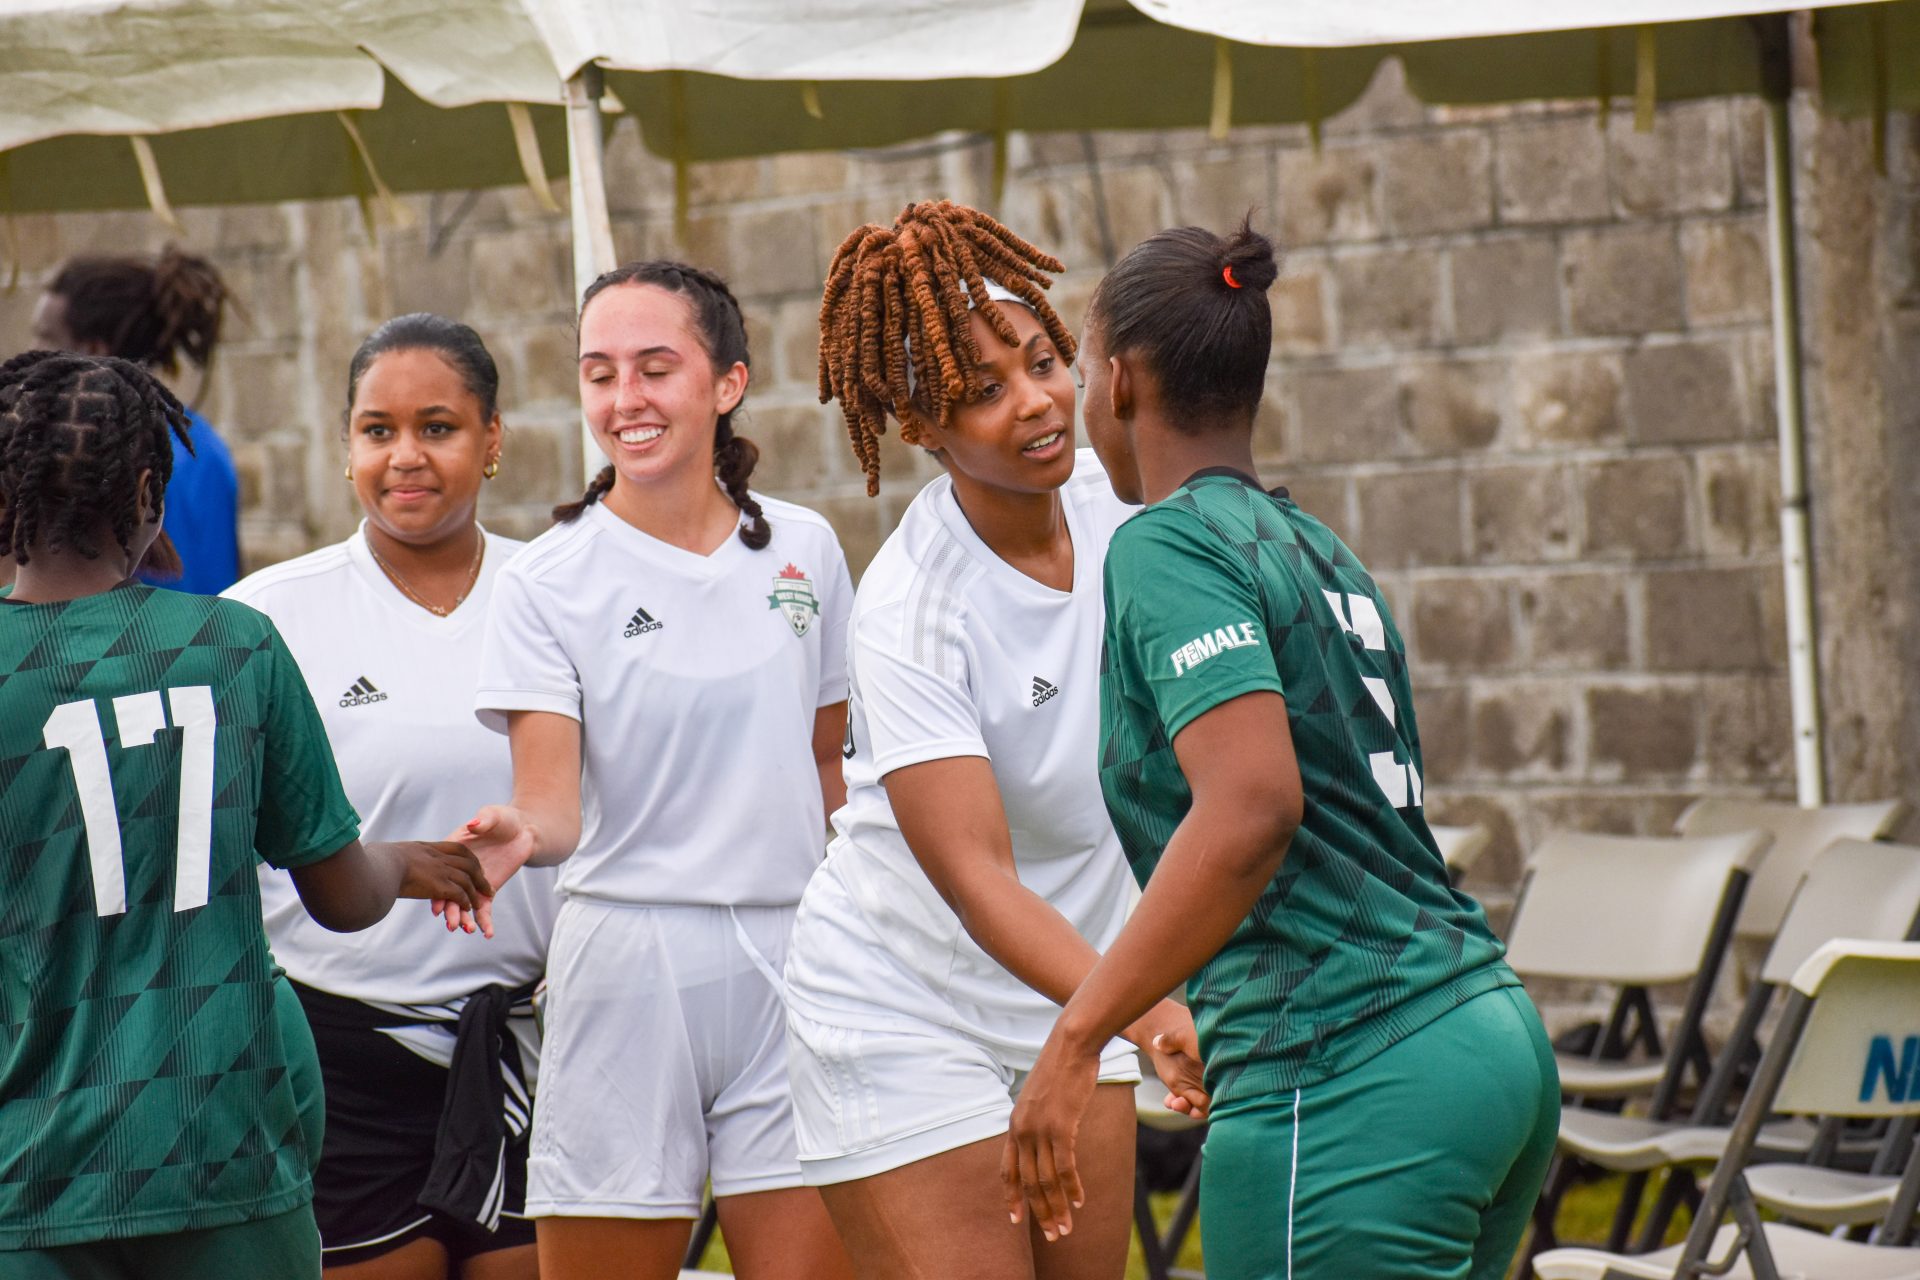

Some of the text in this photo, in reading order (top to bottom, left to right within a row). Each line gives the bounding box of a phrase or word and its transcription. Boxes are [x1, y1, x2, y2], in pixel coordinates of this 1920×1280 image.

[623, 620, 663, 639] adidas
[1170, 622, 1260, 678] FEMALE
[339, 690, 388, 709] adidas
[1033, 685, 1058, 708] adidas
[42, 685, 218, 917] 17
